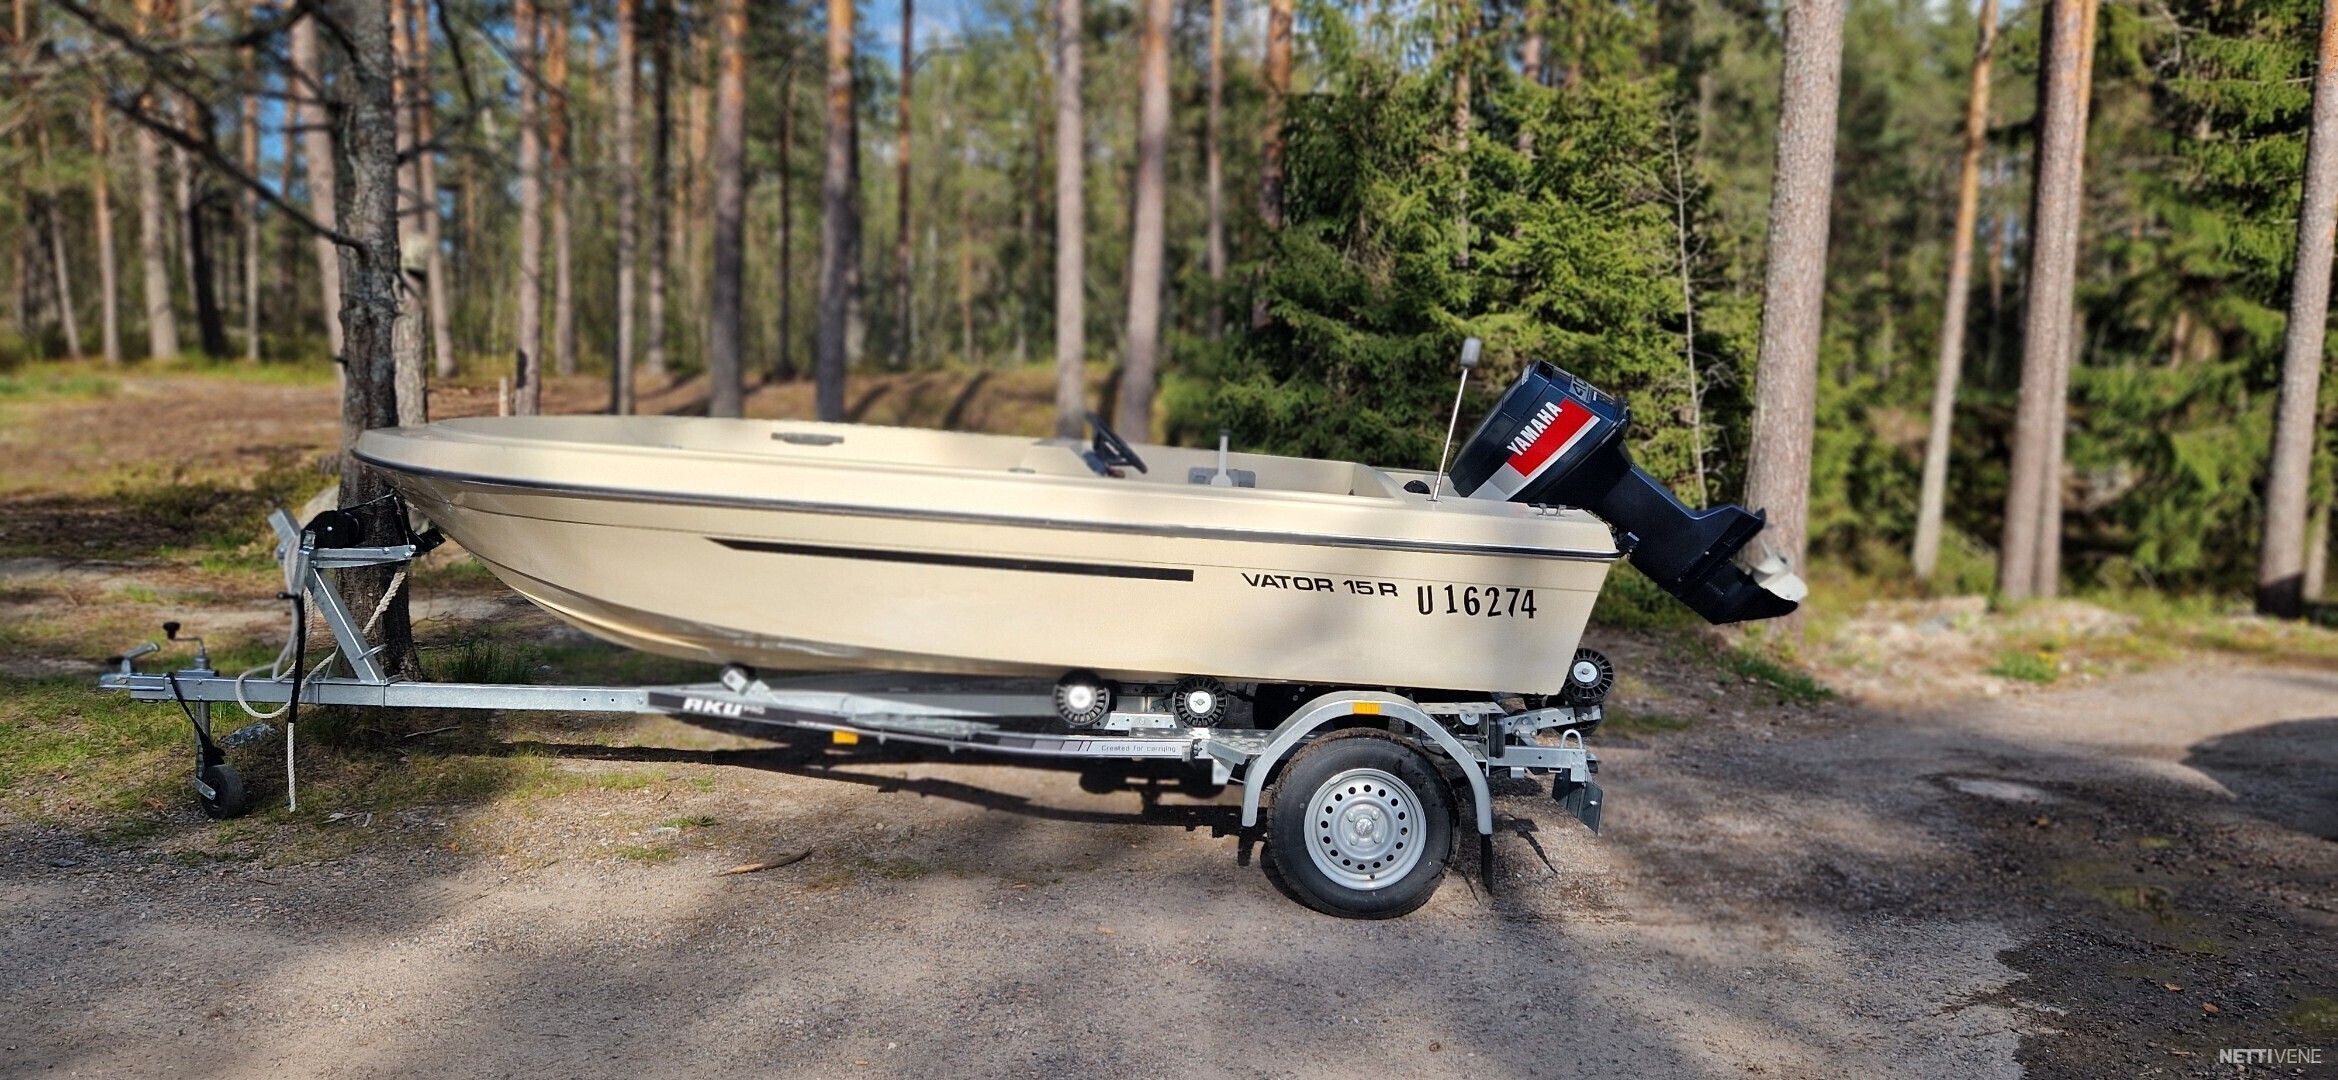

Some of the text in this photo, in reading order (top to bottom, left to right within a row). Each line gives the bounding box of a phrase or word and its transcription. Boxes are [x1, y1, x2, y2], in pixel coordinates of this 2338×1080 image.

[1506, 401, 1564, 457] YAMAHA
[1241, 572, 1335, 593] VATOR
[1417, 584, 1538, 619] U 16274
[683, 697, 743, 718] AKU
[1101, 744, 1176, 753] Created for carrying
